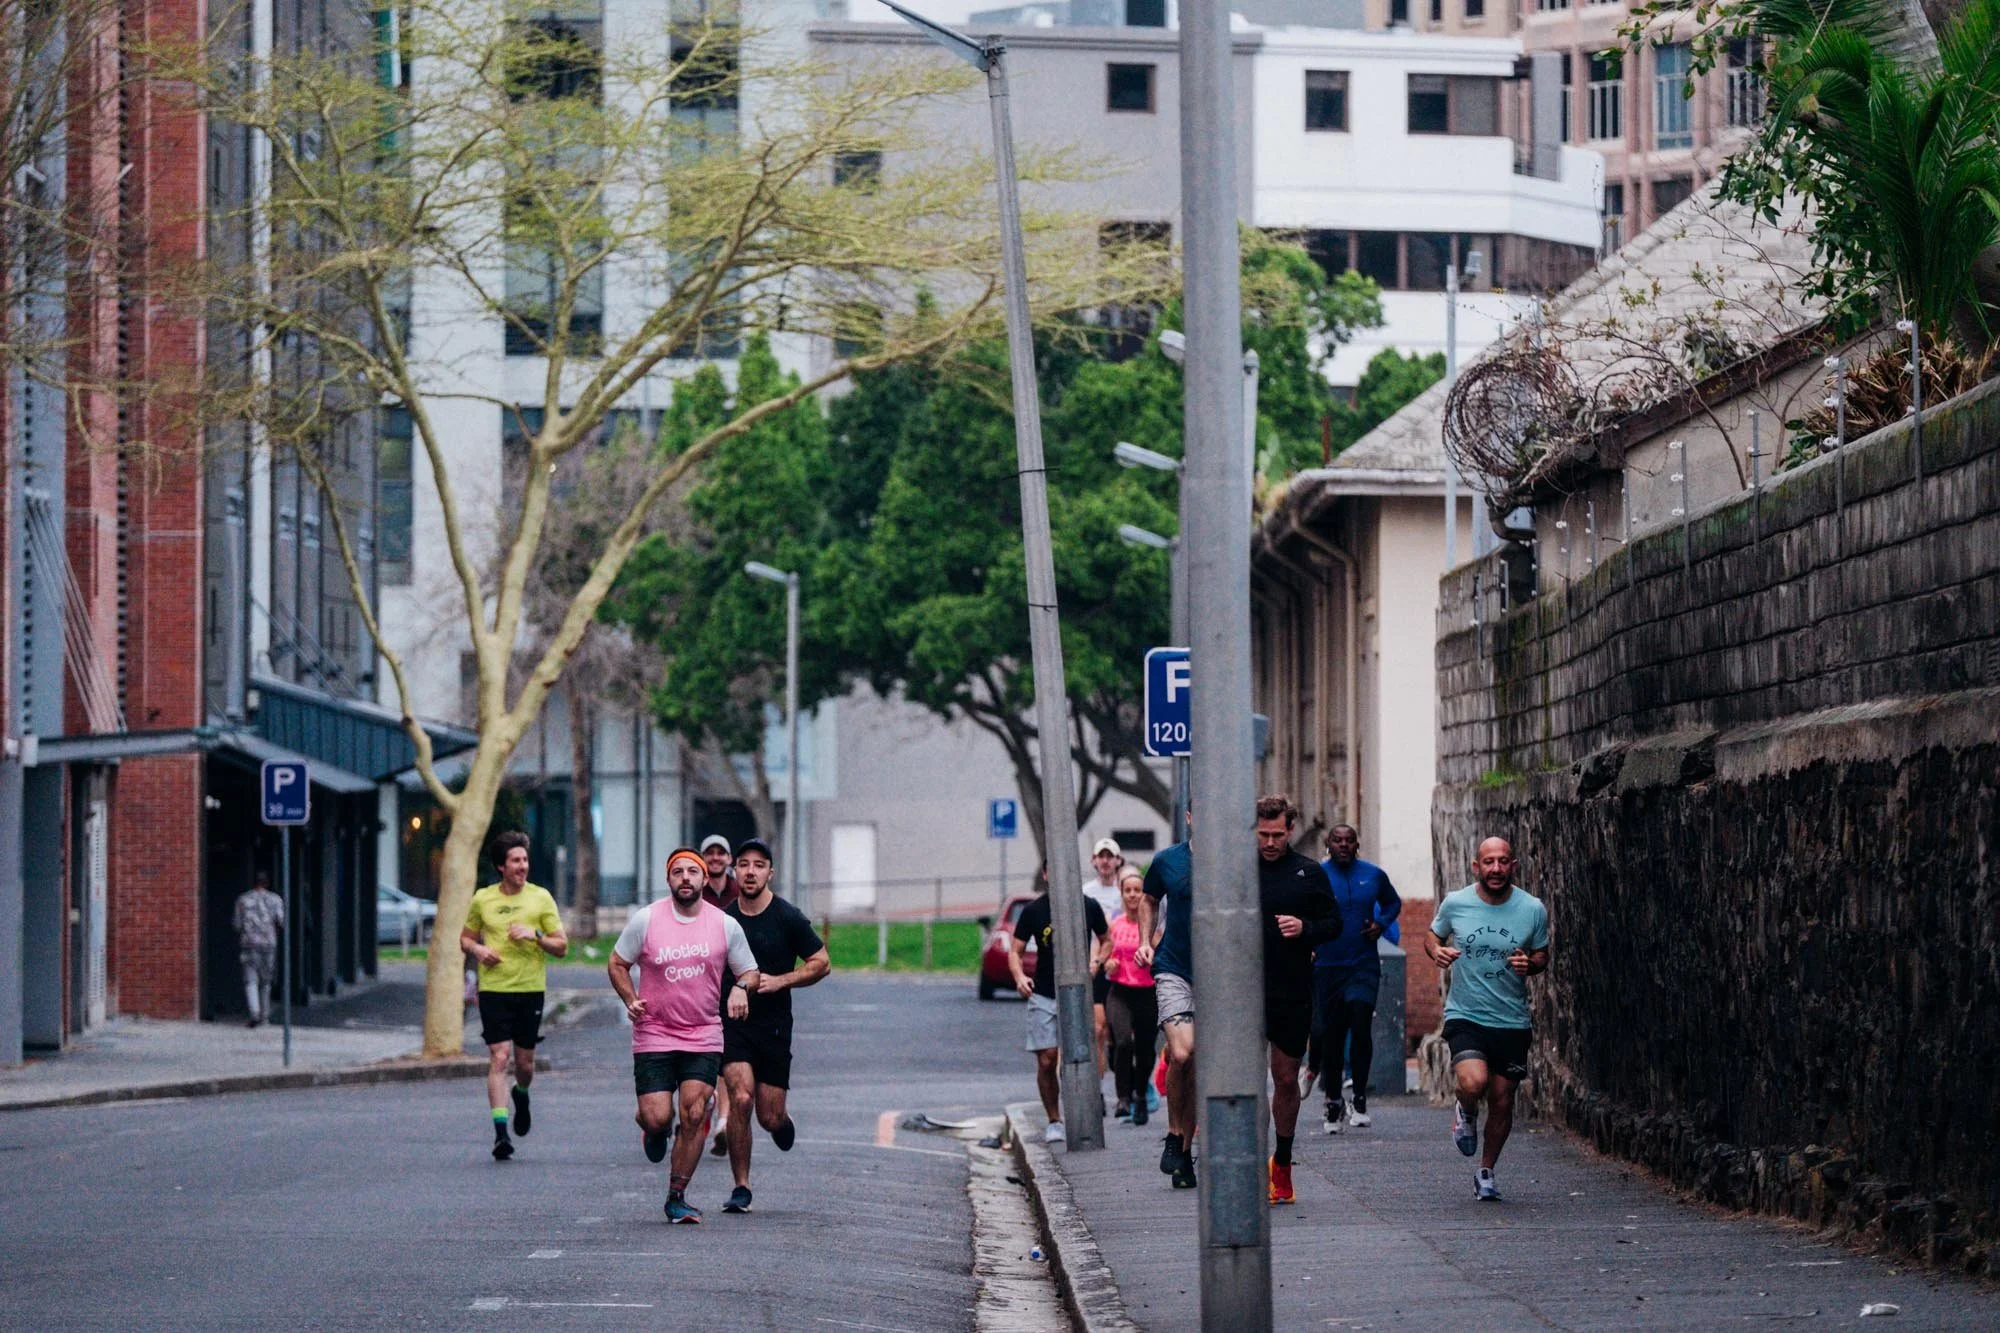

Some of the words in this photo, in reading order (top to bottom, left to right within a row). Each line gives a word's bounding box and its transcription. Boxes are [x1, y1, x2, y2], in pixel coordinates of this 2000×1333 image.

[1152, 722, 1187, 743] 120
[273, 766, 297, 796] P
[996, 800, 1012, 819] P
[655, 941, 710, 965] Motley
[664, 962, 706, 984] Crew
